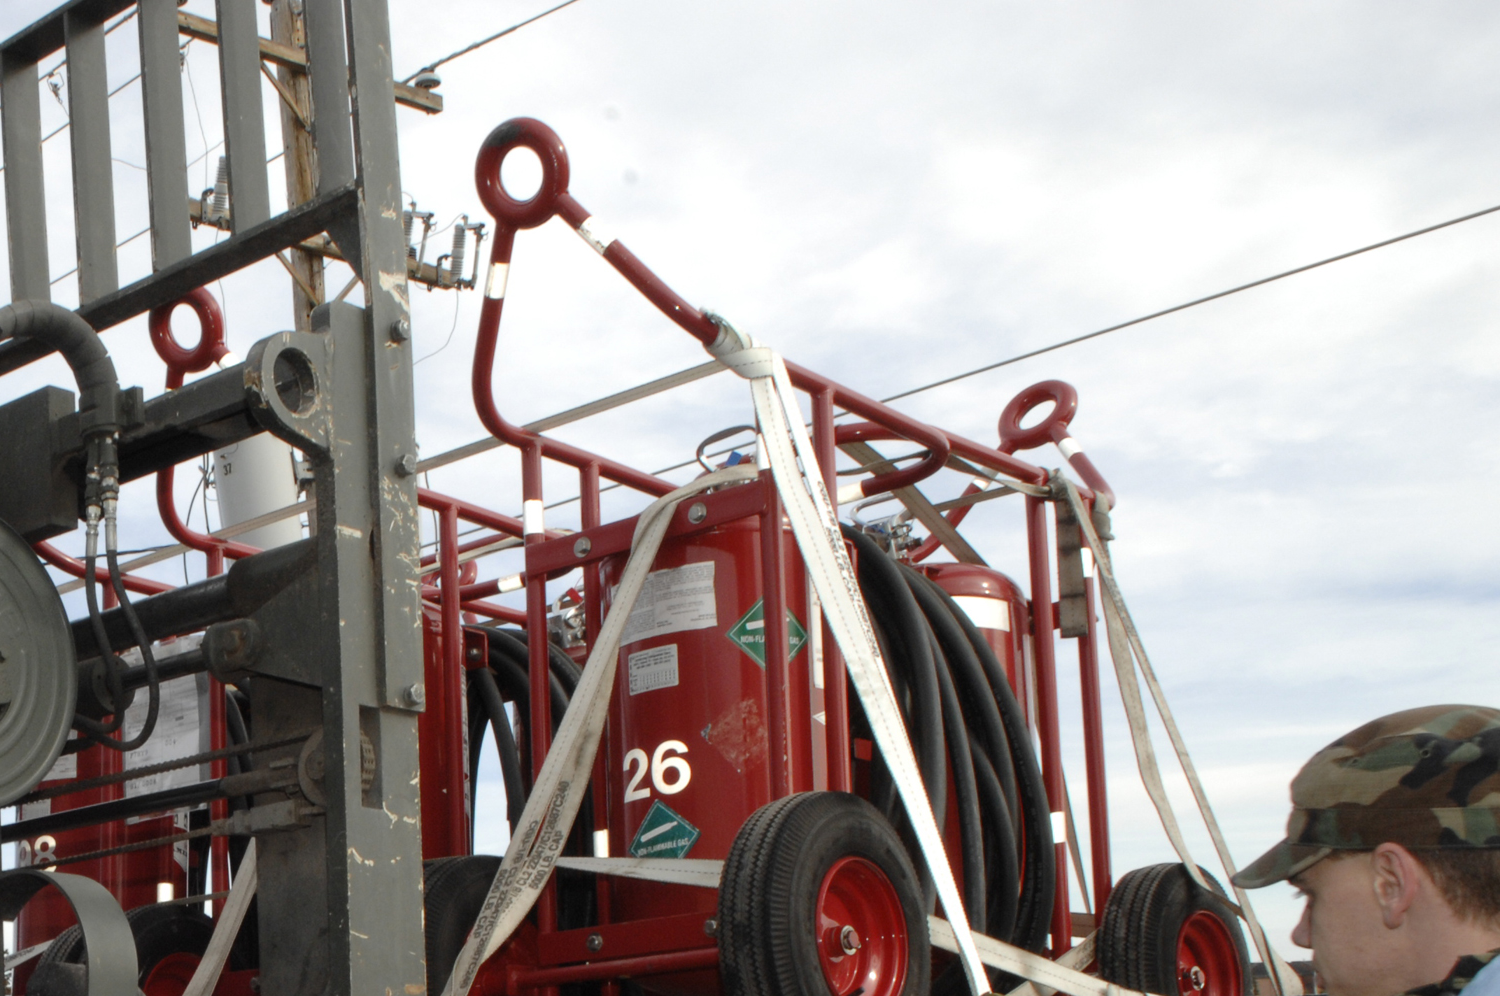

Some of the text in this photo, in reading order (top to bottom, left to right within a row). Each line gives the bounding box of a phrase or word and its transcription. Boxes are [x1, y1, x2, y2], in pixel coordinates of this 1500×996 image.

[623, 740, 692, 803] 26
[553, 830, 564, 851] CAP
[473, 915, 488, 939] CAP
